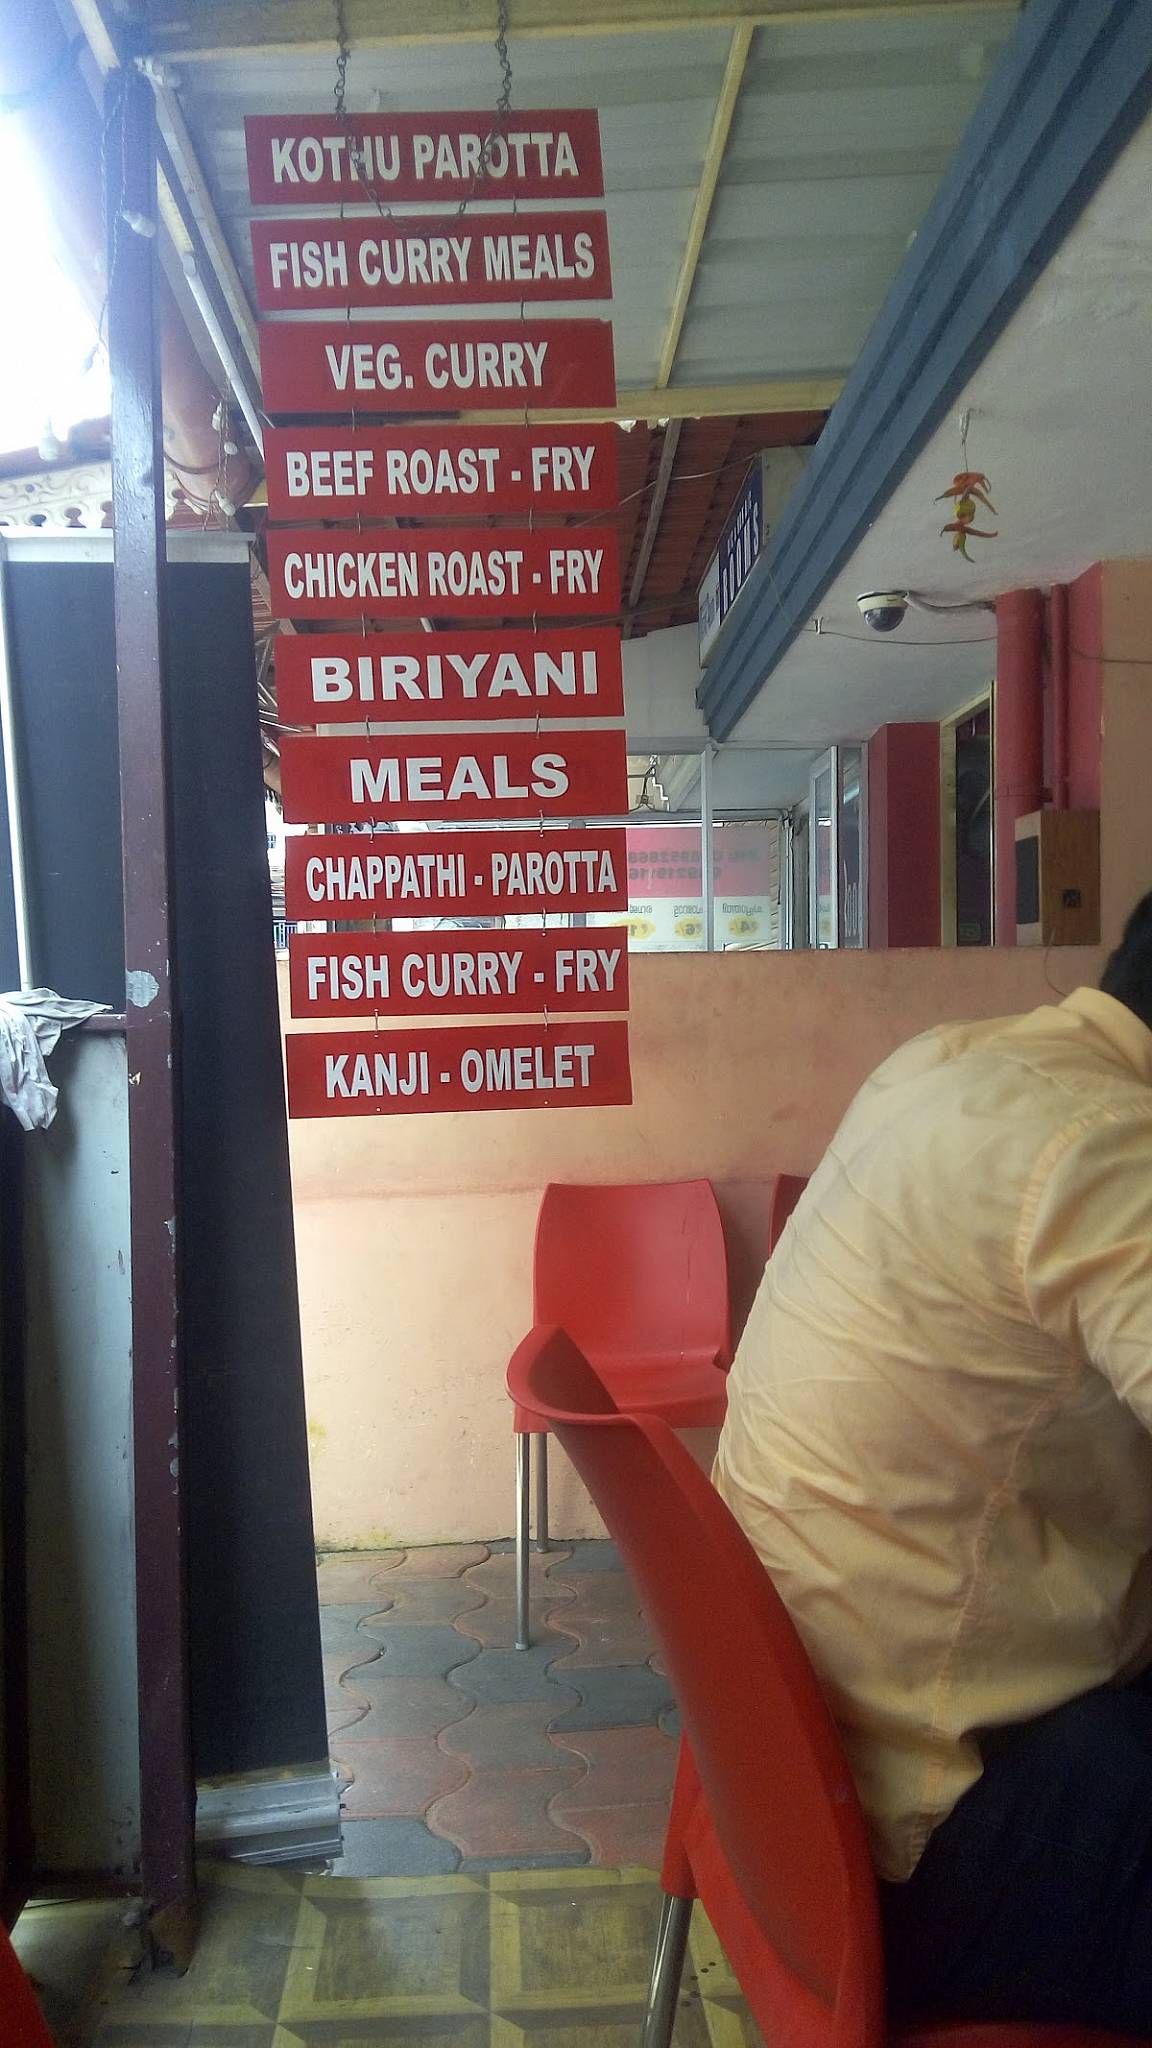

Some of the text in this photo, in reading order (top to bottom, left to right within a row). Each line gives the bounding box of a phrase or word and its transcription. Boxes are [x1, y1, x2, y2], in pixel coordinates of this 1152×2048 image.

[413, 133, 579, 179] PAROTTA
[270, 233, 594, 290] FISH CURRY MEALS
[325, 342, 547, 390] VEG. CURRY
[286, 450, 373, 497] BEEF
[387, 448, 499, 494] ROAST
[532, 446, 595, 491] FRY
[284, 552, 418, 599] CHICKEN
[428, 551, 523, 596] ROAST
[550, 550, 603, 594] FRY
[311, 651, 597, 702] BIRIYANI
[351, 754, 568, 803] MEALS
[306, 854, 465, 901] CHAPPATHI
[492, 851, 617, 895] PAROTTA
[308, 955, 389, 1000] FISH
[402, 952, 522, 997] CURRY
[556, 949, 621, 992] FRY
[326, 1052, 428, 1097] KANJI
[461, 1045, 594, 1092] OMELET
